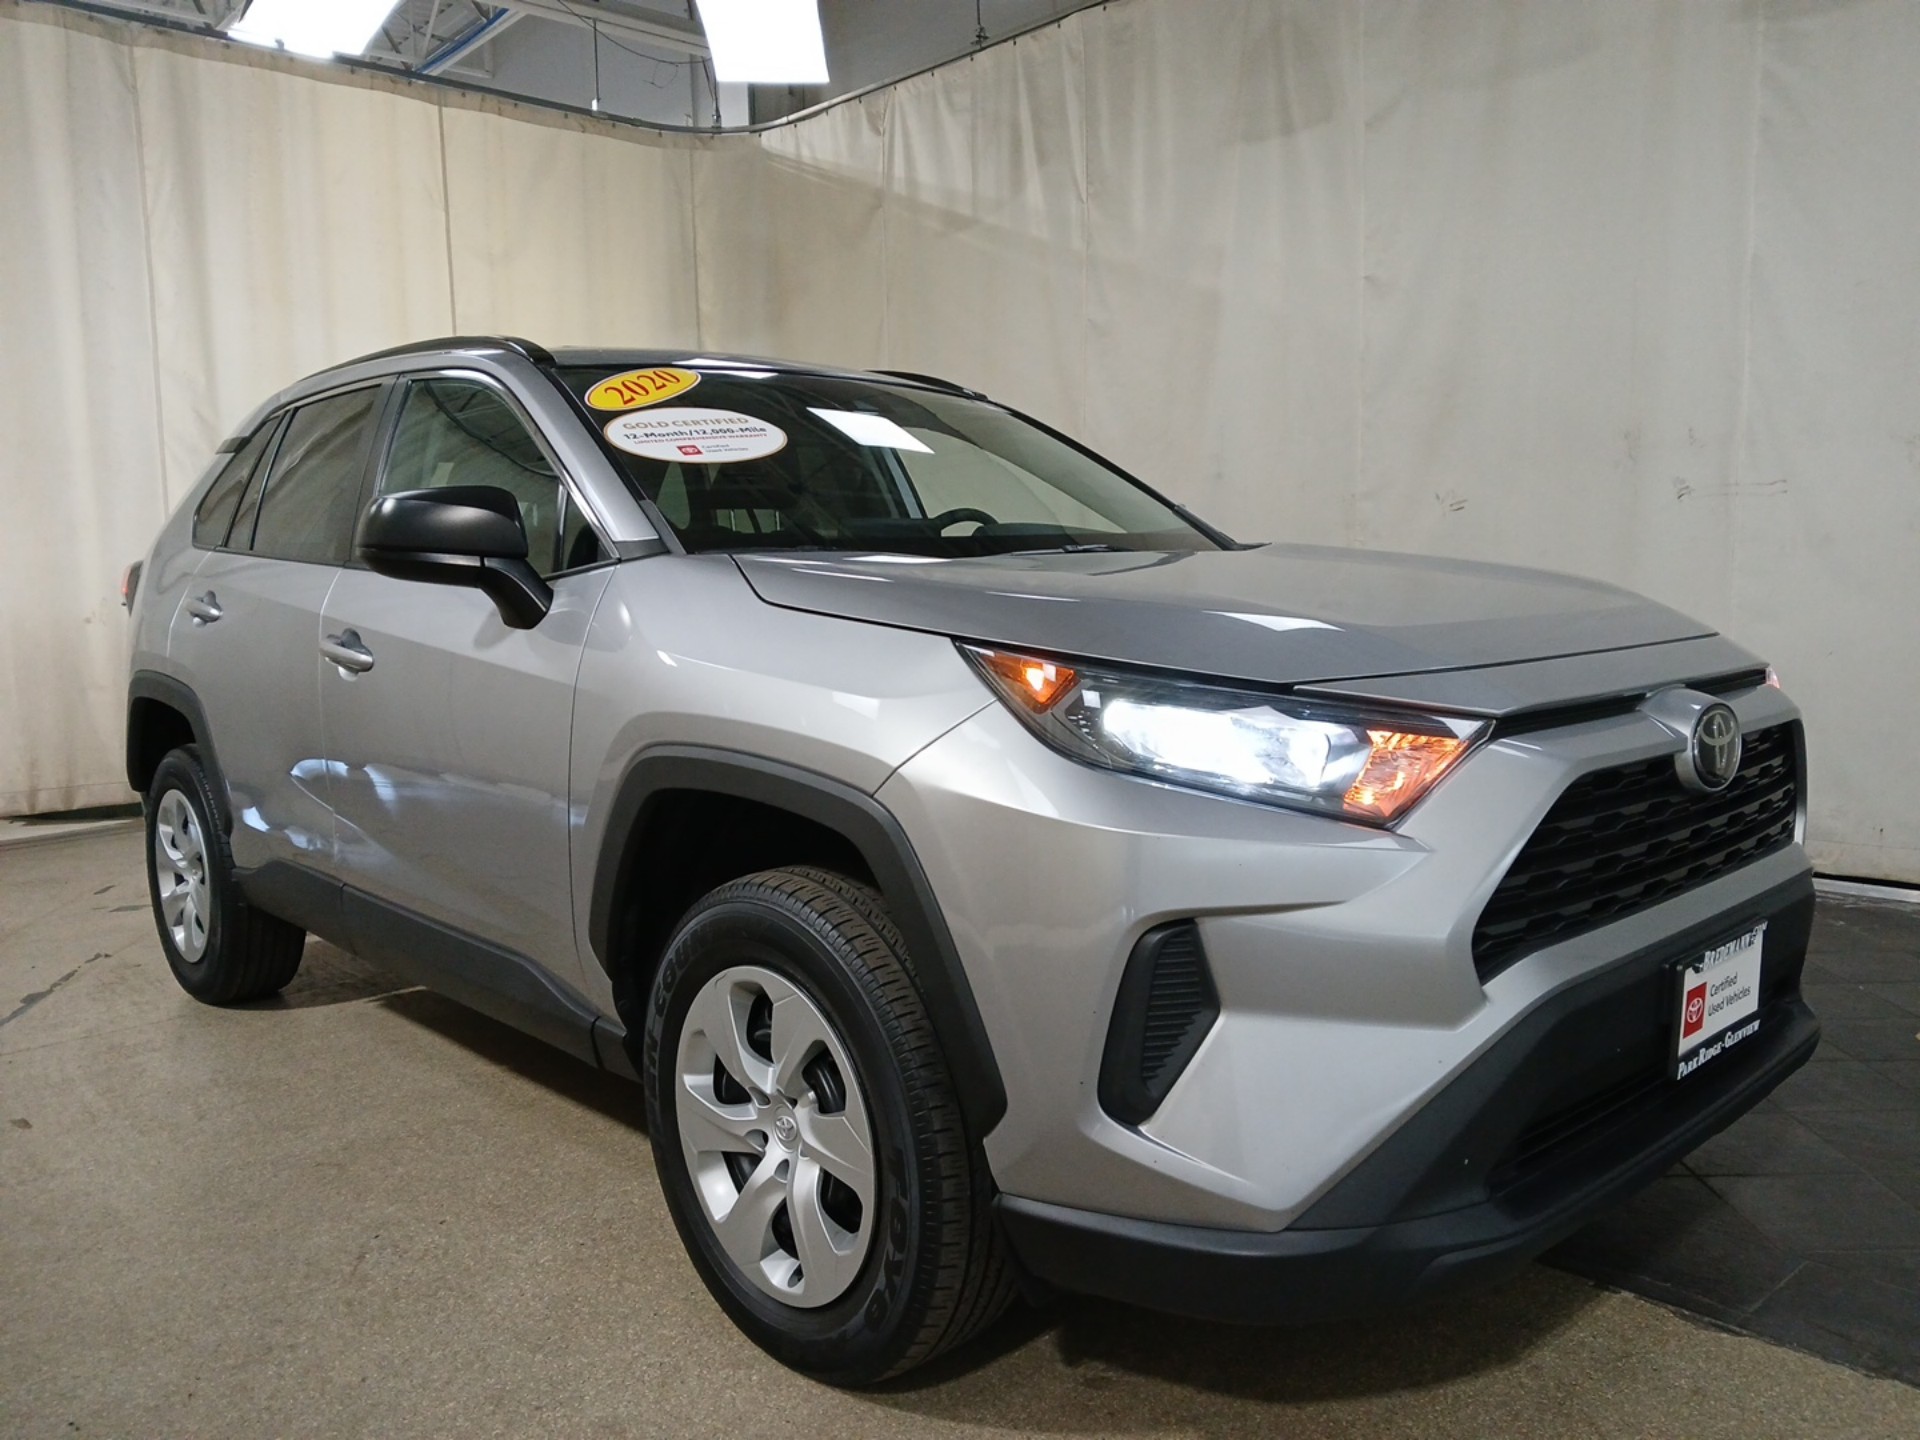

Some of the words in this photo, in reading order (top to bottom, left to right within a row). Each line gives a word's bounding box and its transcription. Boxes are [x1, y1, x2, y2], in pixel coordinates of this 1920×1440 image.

[604, 369, 681, 406] 2020
[623, 421, 669, 430] GOLD
[672, 417, 749, 427] CERTIFIED
[1710, 971, 1738, 998] Certified
[1708, 1000, 1725, 1017] Used
[1726, 986, 1752, 1007] Vehicles
[1677, 1056, 1699, 1081] PARK
